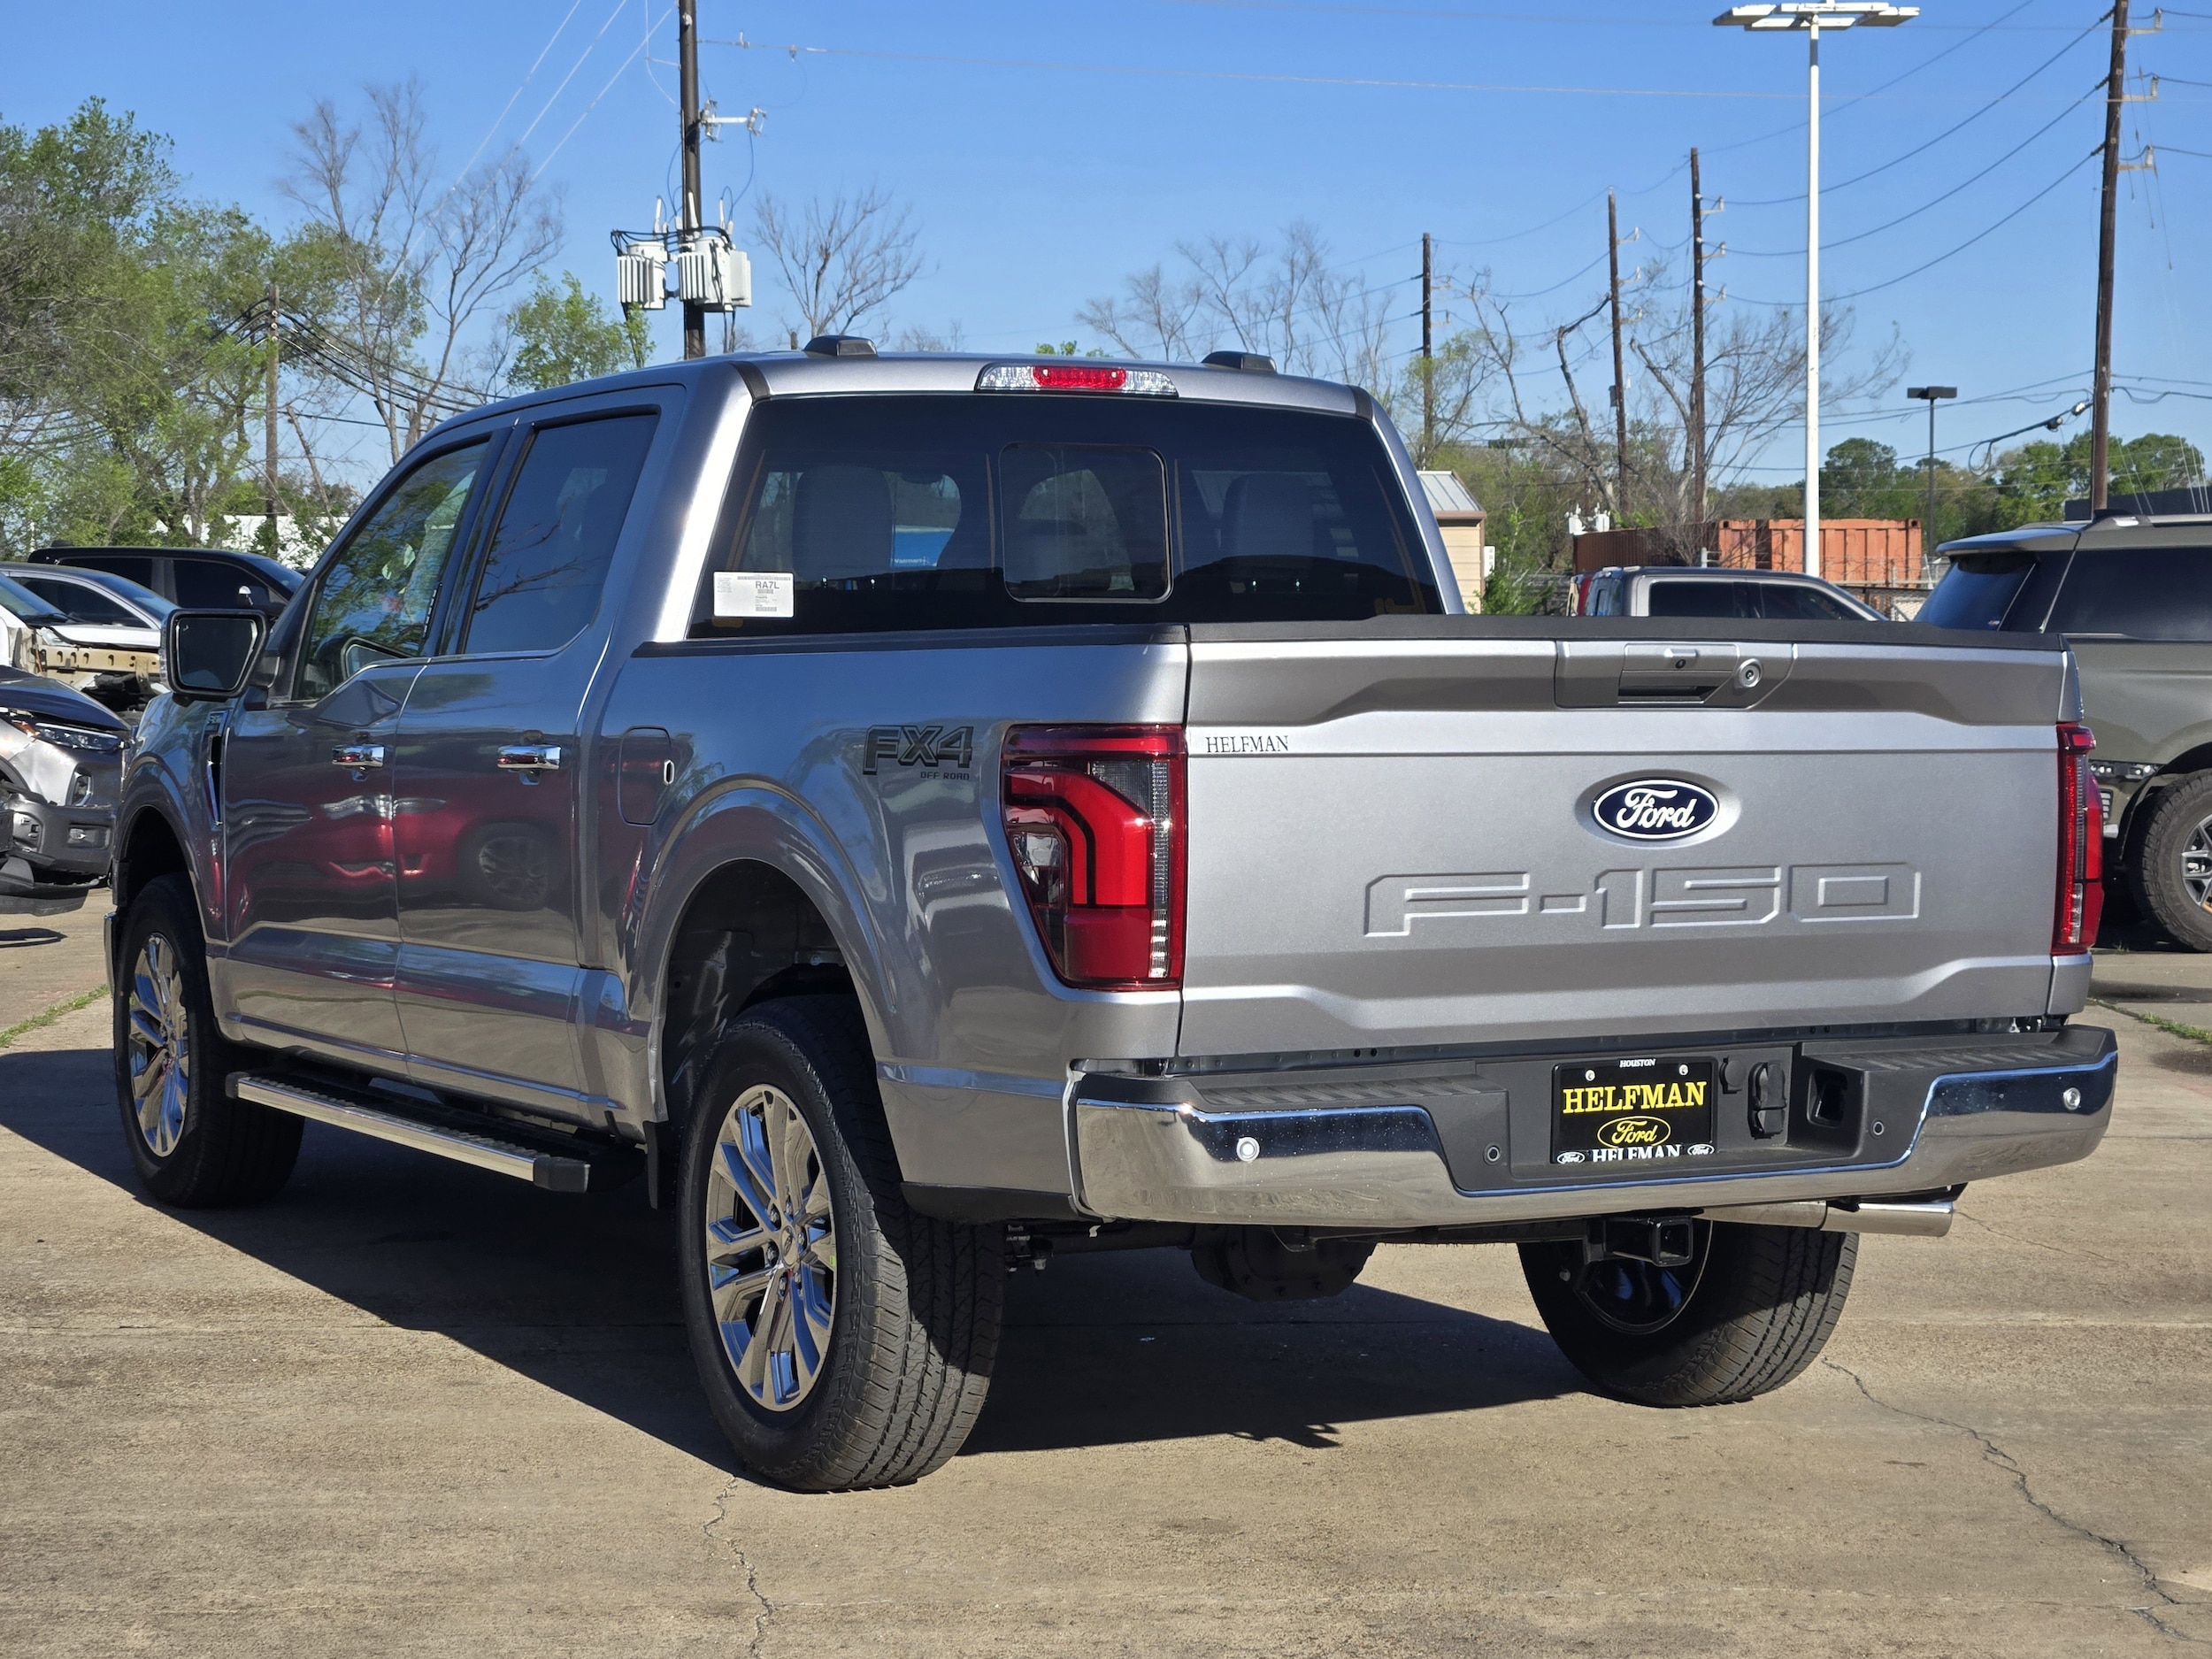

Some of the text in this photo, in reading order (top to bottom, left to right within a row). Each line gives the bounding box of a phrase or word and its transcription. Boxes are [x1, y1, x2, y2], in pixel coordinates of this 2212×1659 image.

[755, 580, 780, 589] RA7L
[863, 724, 974, 776] FX4
[1205, 735, 1288, 753] HELFMAN
[920, 771, 970, 780] OFF ROAD
[1617, 787, 1697, 828] Ford
[1363, 862, 1922, 938] F-150
[1619, 1058, 1656, 1068] HOUSTON
[1563, 1081, 1708, 1114] HELFMAN
[1611, 1120, 1658, 1144] Ford
[1592, 1144, 1682, 1163] HELFMAN
